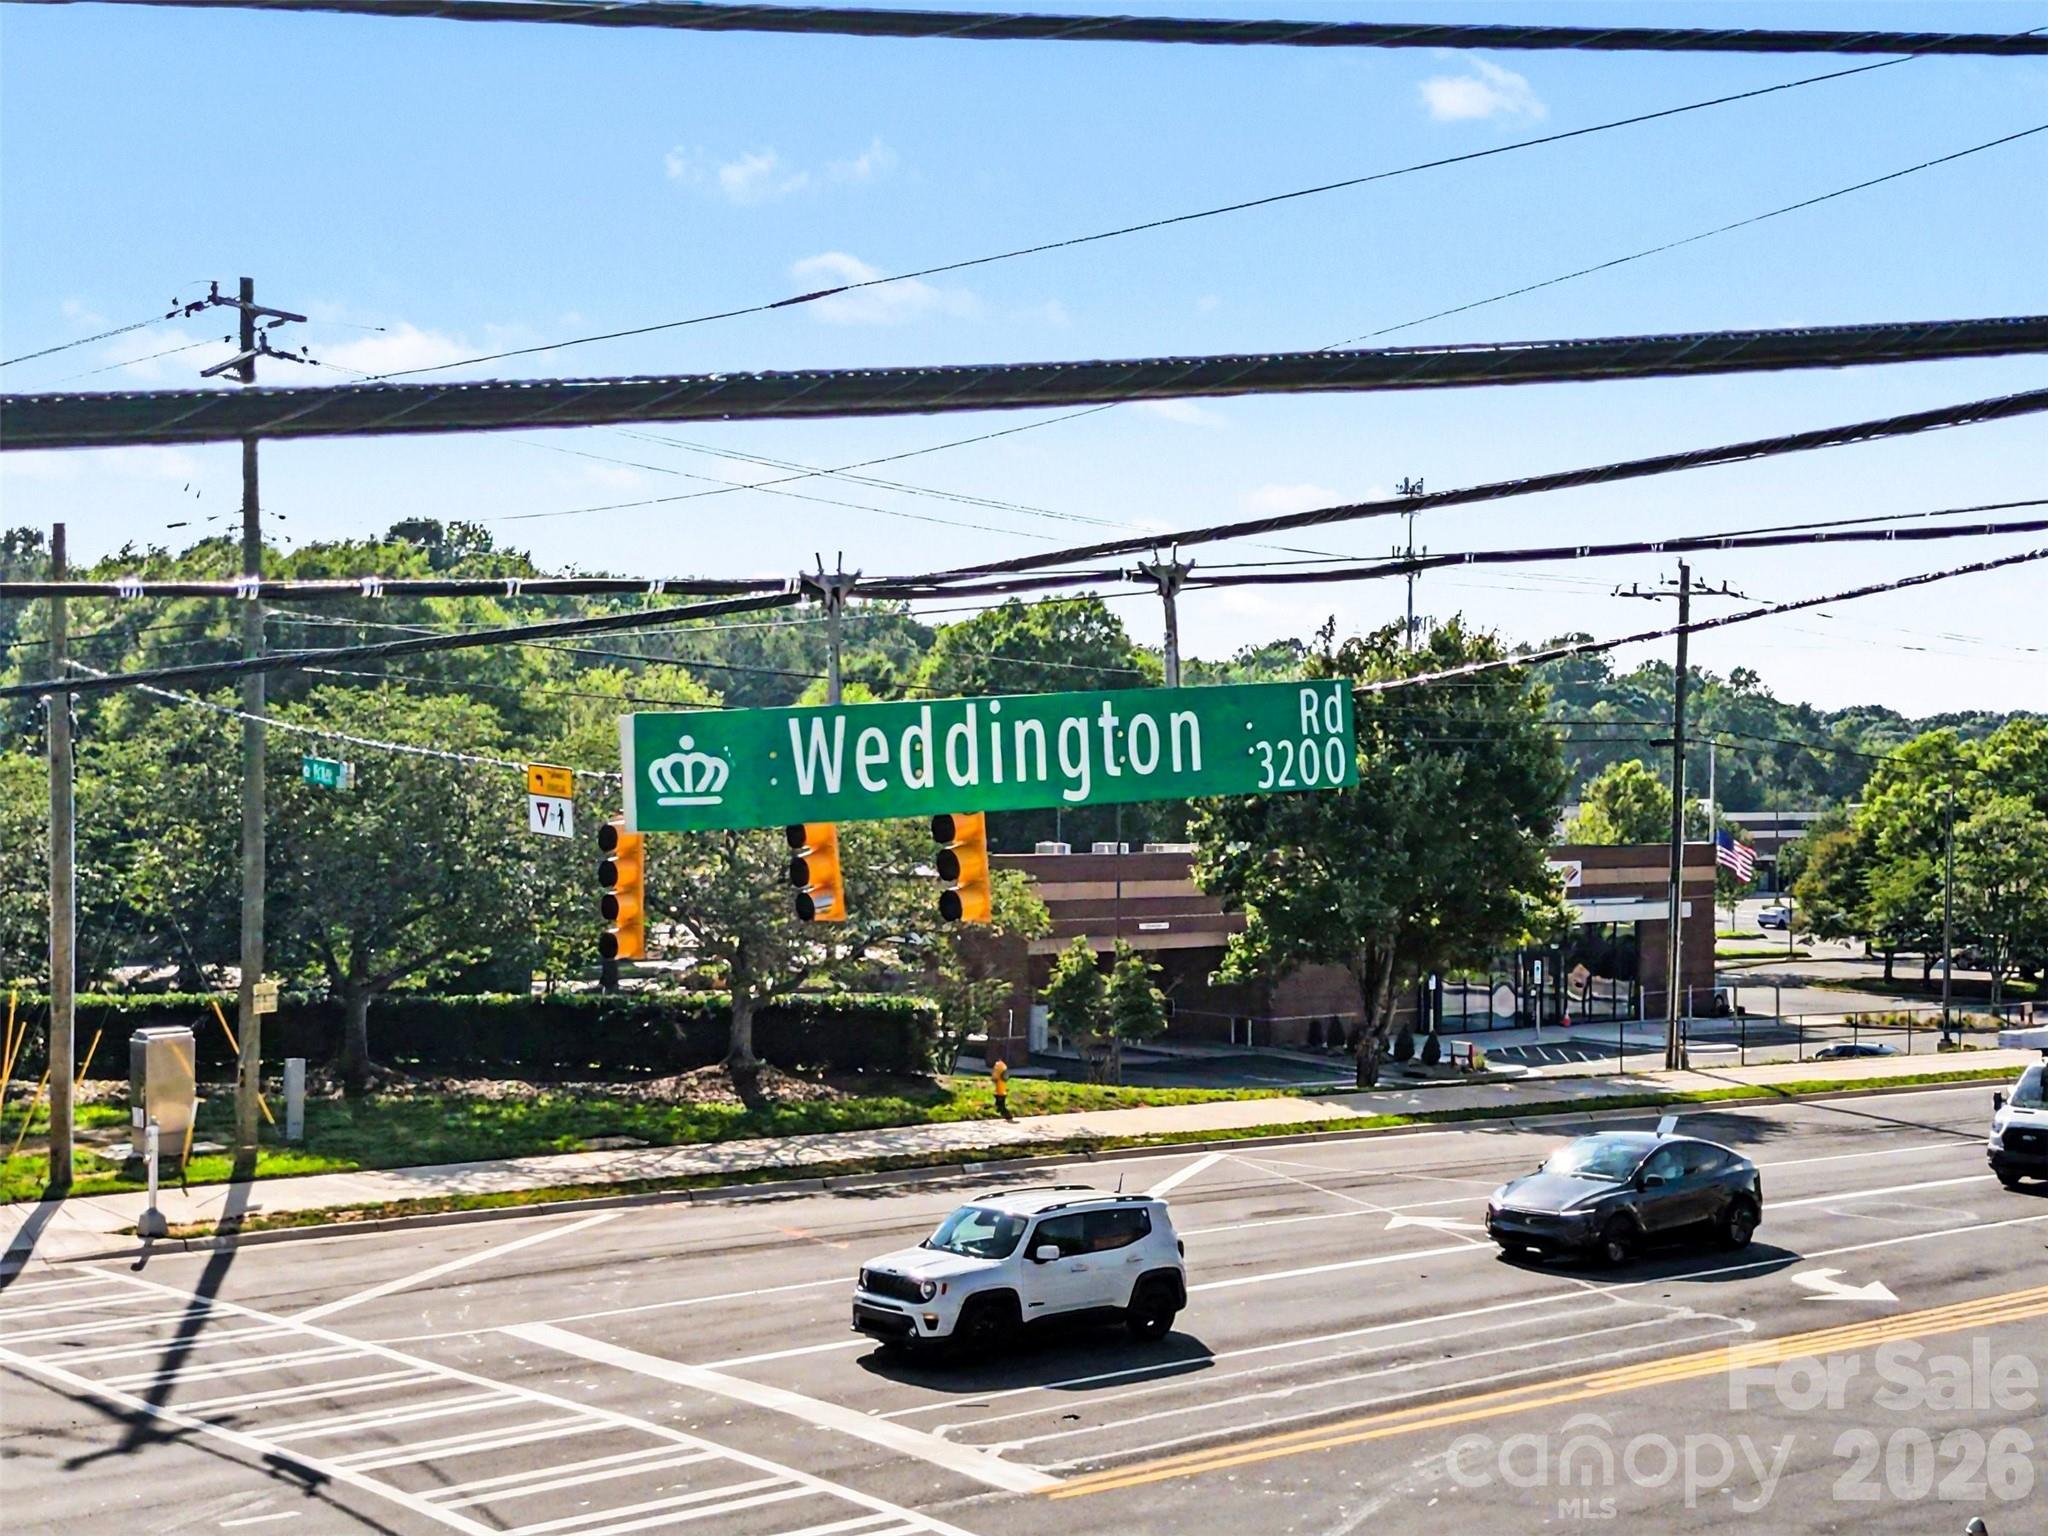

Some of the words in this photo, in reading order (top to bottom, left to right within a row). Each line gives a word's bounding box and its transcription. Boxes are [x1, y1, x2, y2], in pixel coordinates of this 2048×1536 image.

[788, 699, 1202, 801] Weddington
[1299, 683, 1344, 735] Rd
[1256, 736, 1346, 789] 3200
